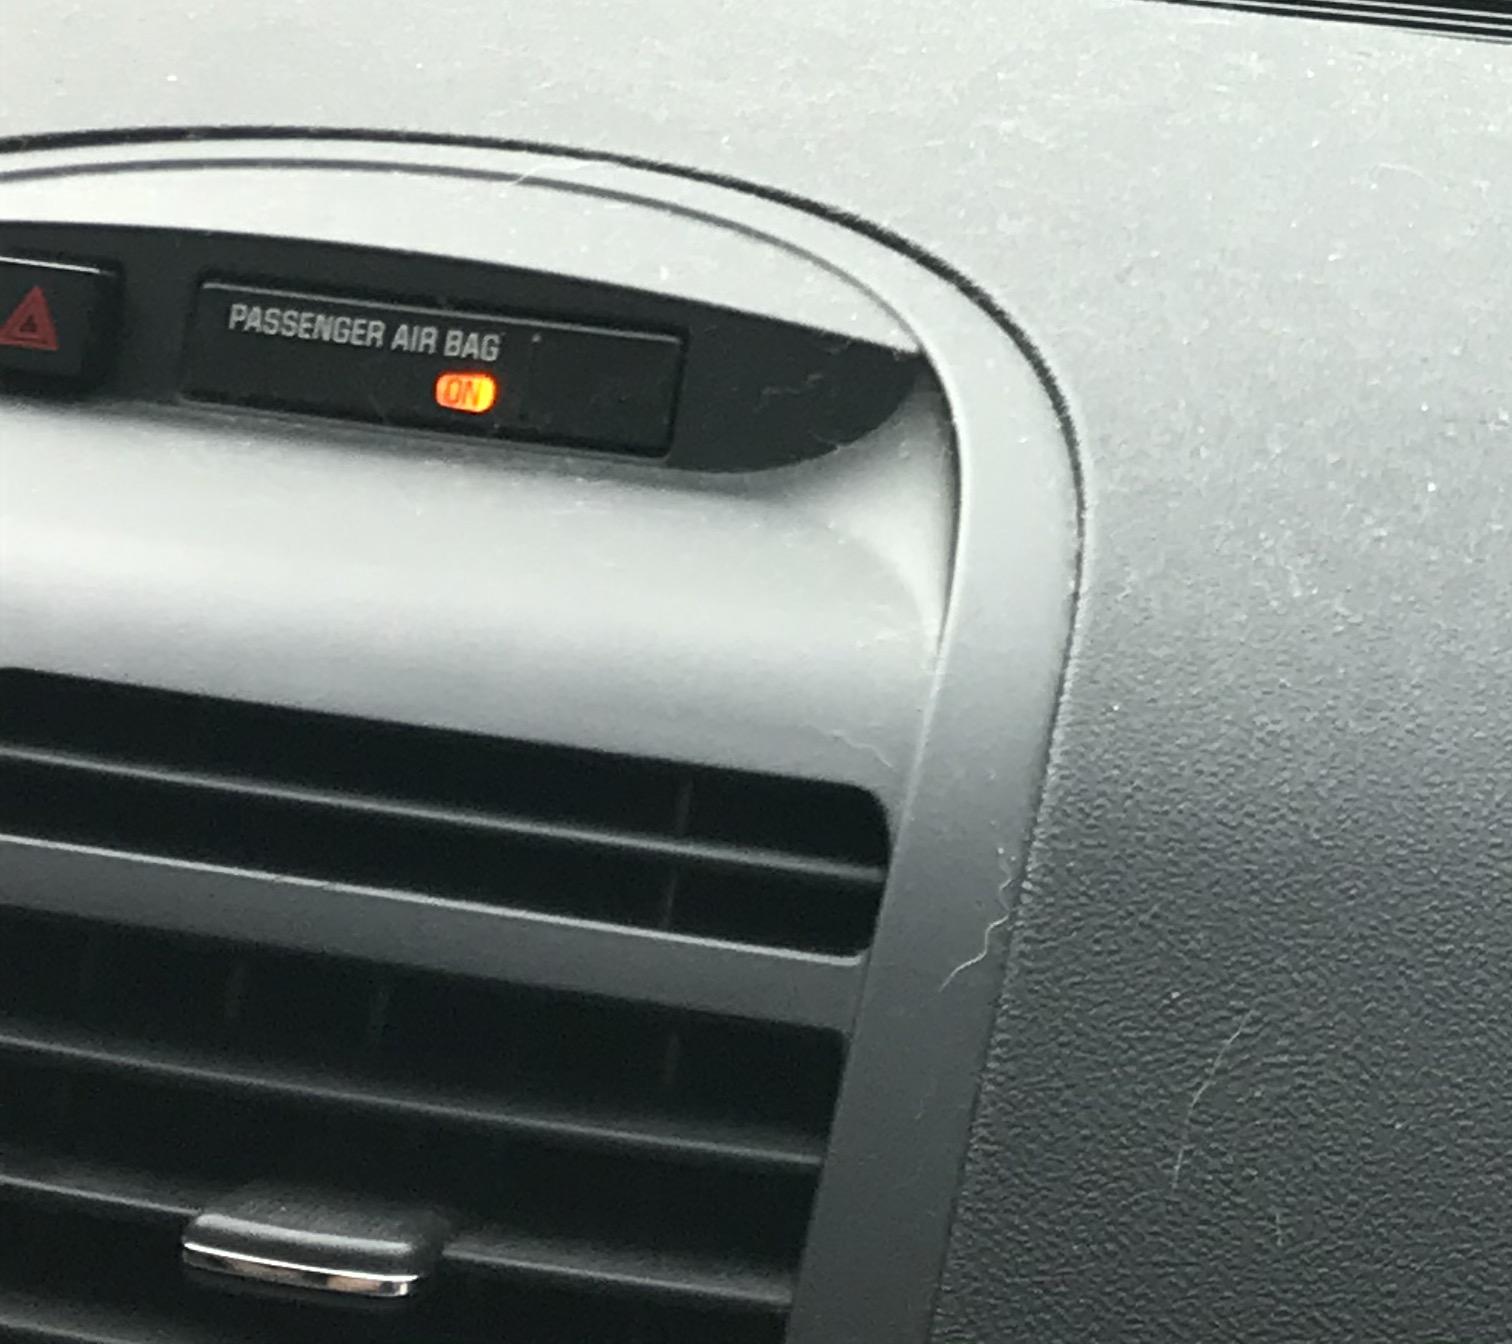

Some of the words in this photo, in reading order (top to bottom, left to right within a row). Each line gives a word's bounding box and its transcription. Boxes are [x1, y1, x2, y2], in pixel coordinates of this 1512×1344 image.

[229, 303, 385, 348] PASSENGER
[390, 324, 437, 355] AIR
[444, 330, 500, 362] BAG
[442, 378, 483, 408] ON
